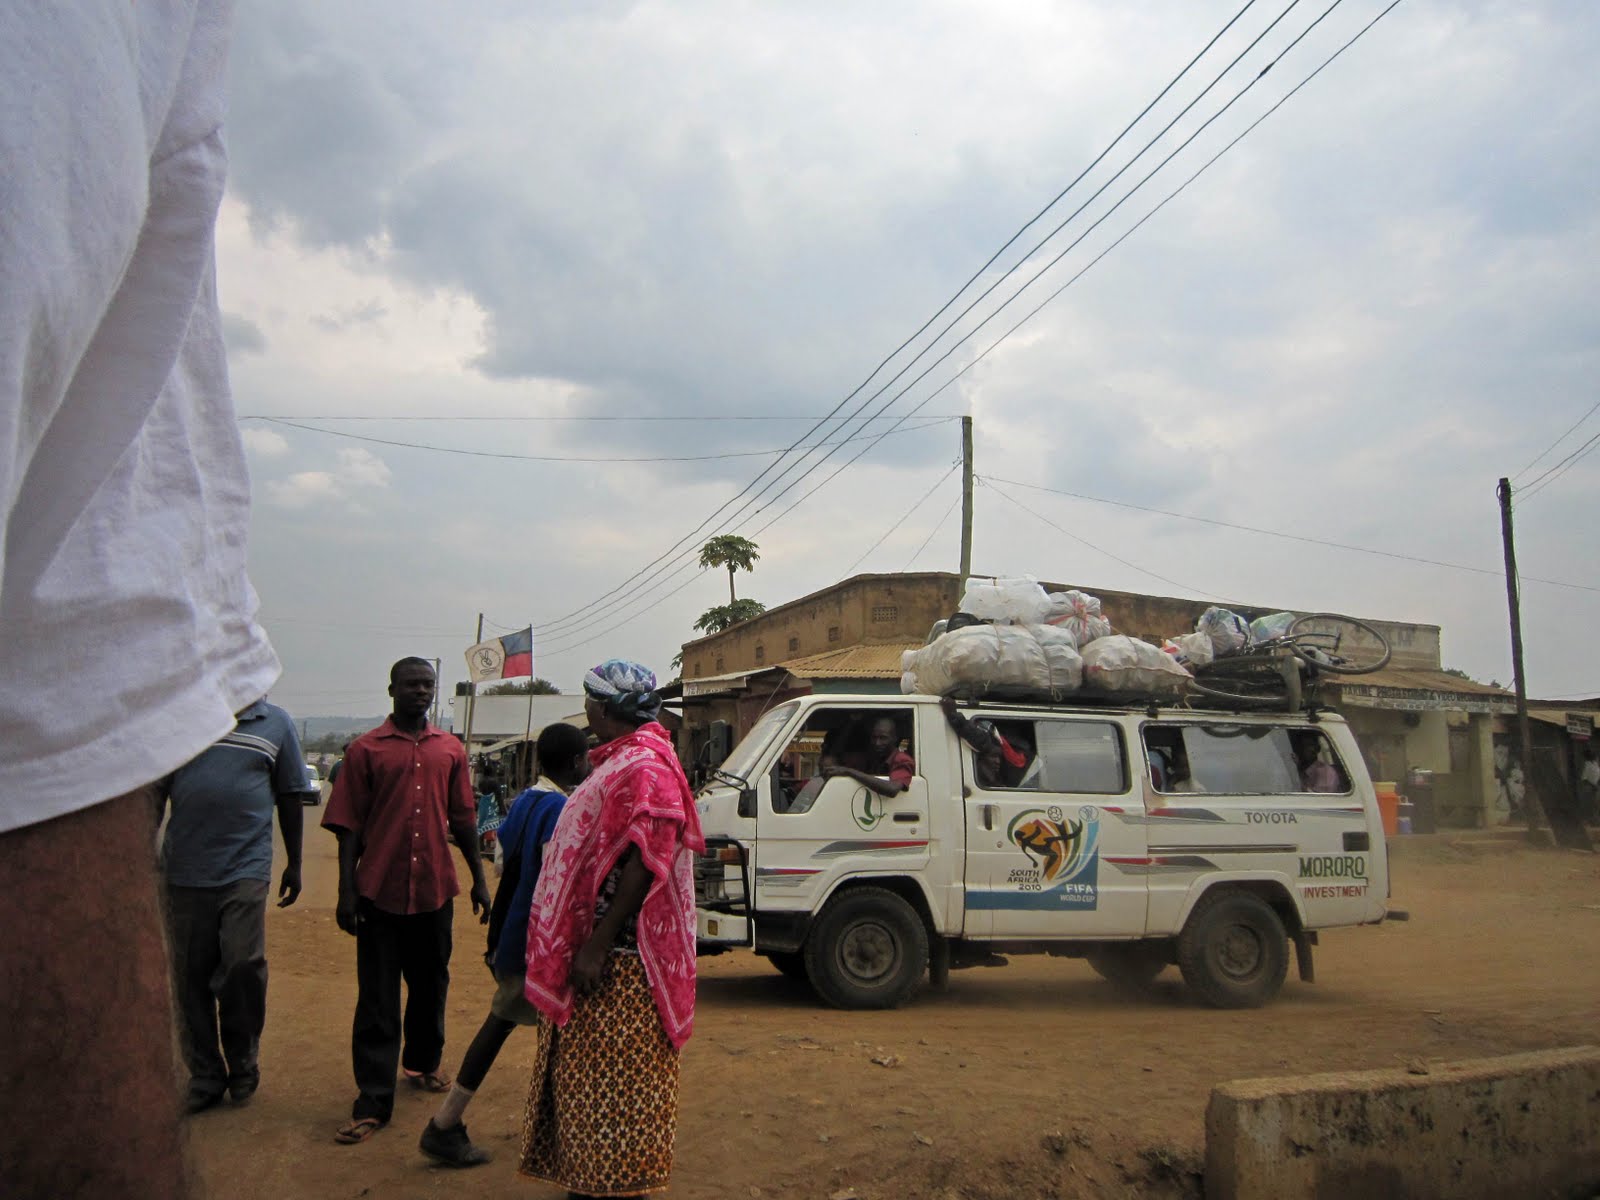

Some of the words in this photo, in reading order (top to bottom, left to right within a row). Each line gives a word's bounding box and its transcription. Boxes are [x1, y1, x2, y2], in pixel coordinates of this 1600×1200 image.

[1245, 811, 1298, 824] TOYOTA
[1010, 869, 1040, 877] SOUTH
[1299, 856, 1368, 880] MORORO
[1066, 883, 1094, 894] FIFA
[1304, 886, 1368, 898] INVESTMENT
[1060, 894, 1081, 902] WORLD
